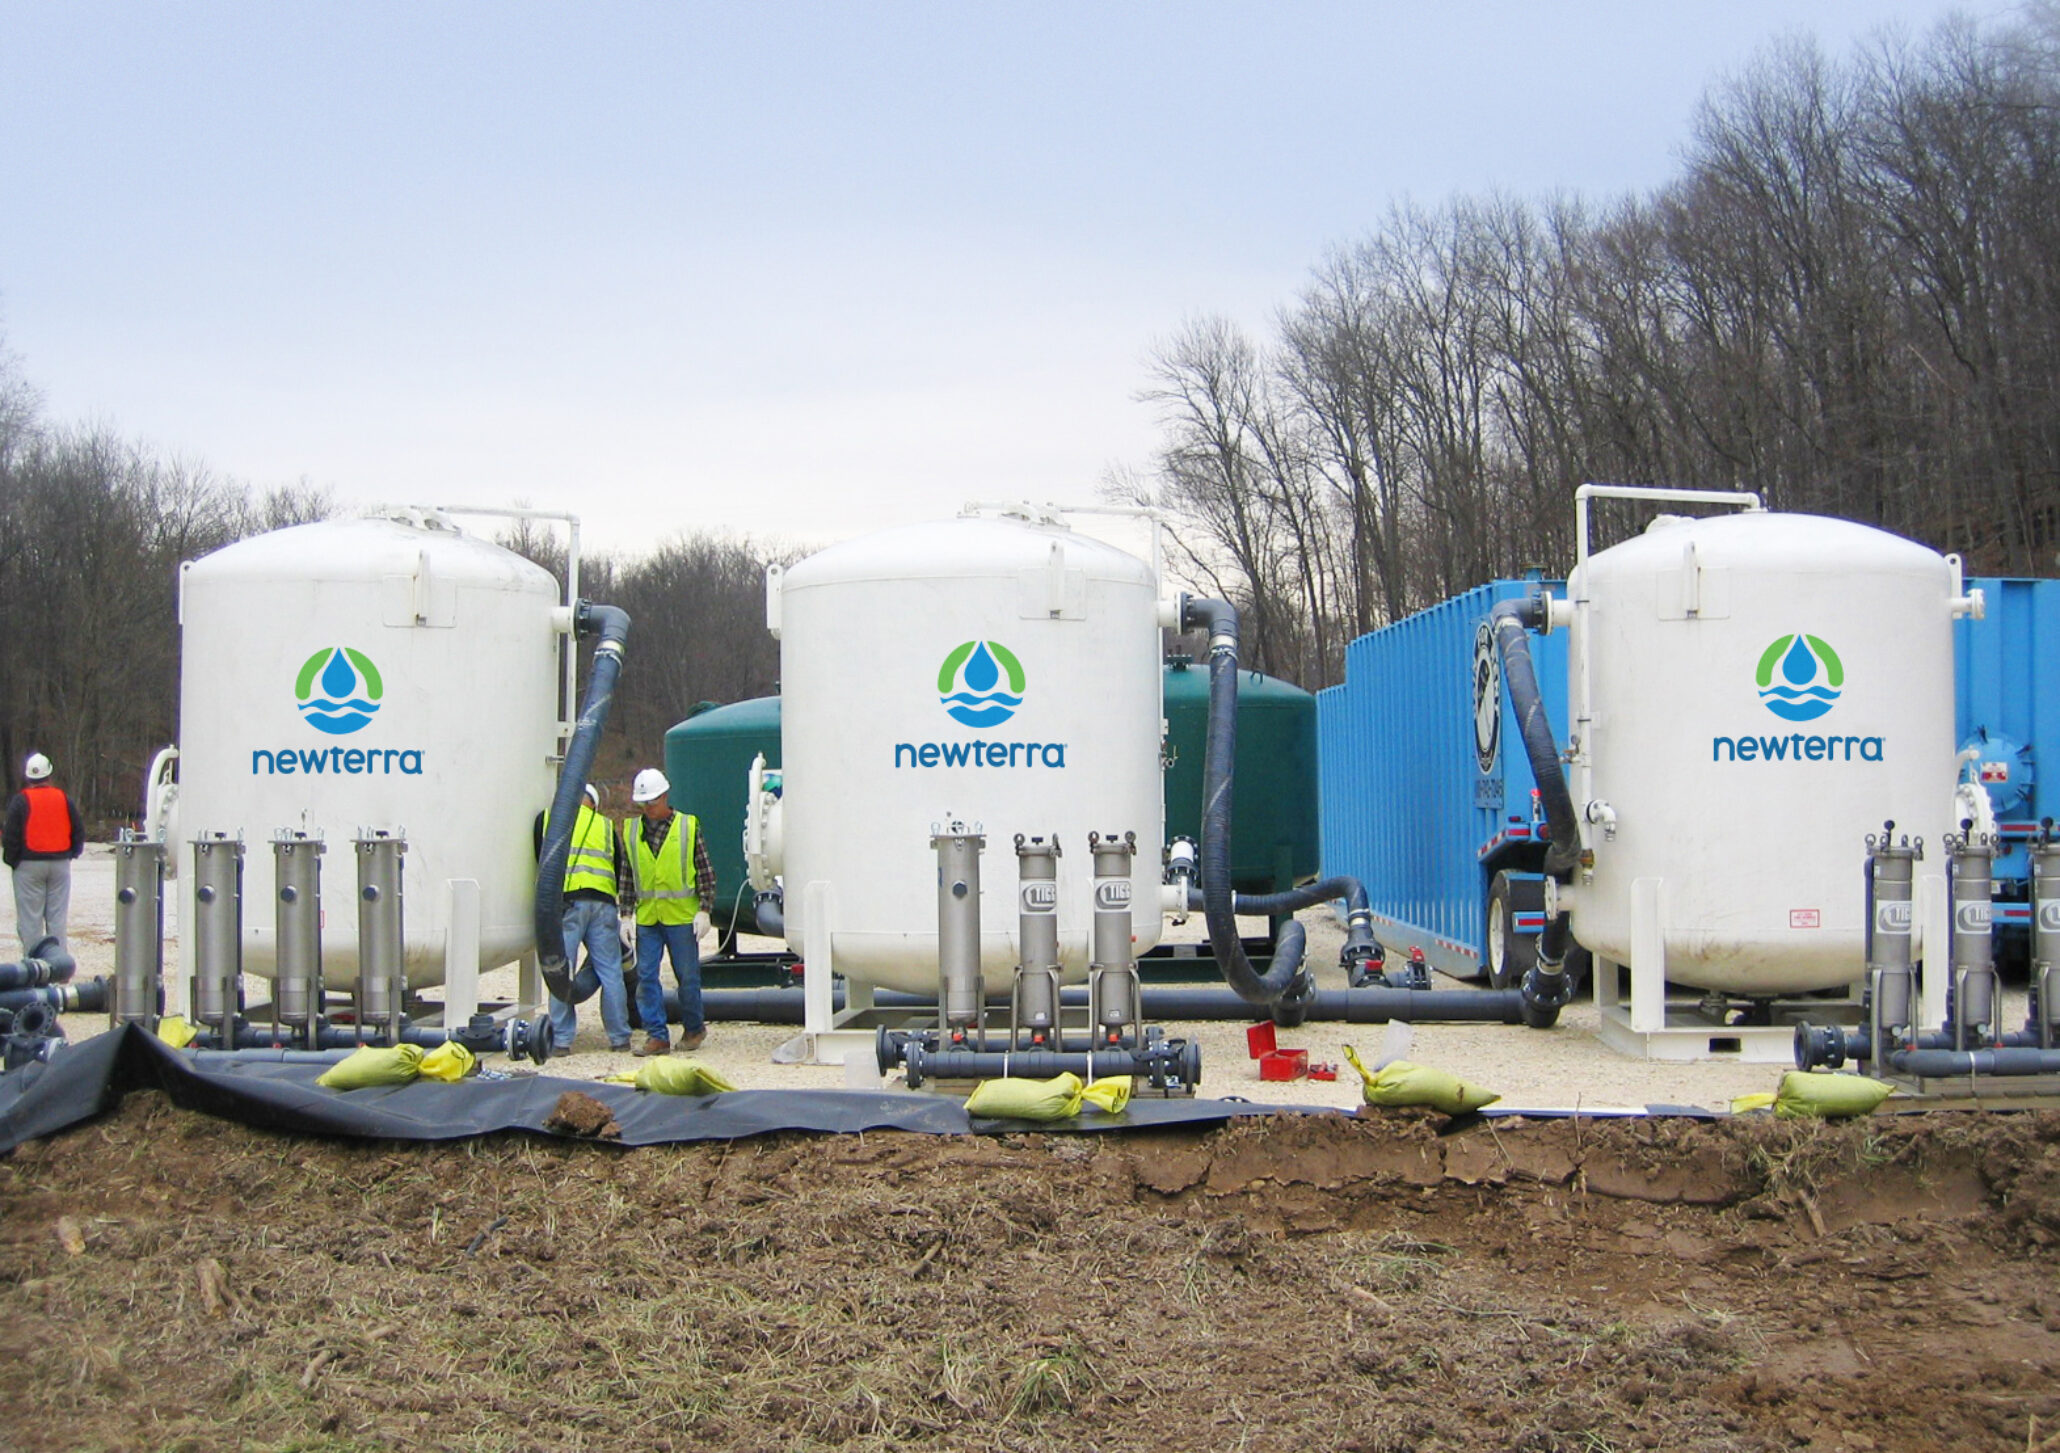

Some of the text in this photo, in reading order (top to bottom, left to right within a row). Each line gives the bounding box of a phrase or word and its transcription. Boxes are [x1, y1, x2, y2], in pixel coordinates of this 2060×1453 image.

[252, 746, 423, 775] newterra
[896, 740, 1066, 768] newterra
[1713, 734, 1884, 762] newterra
